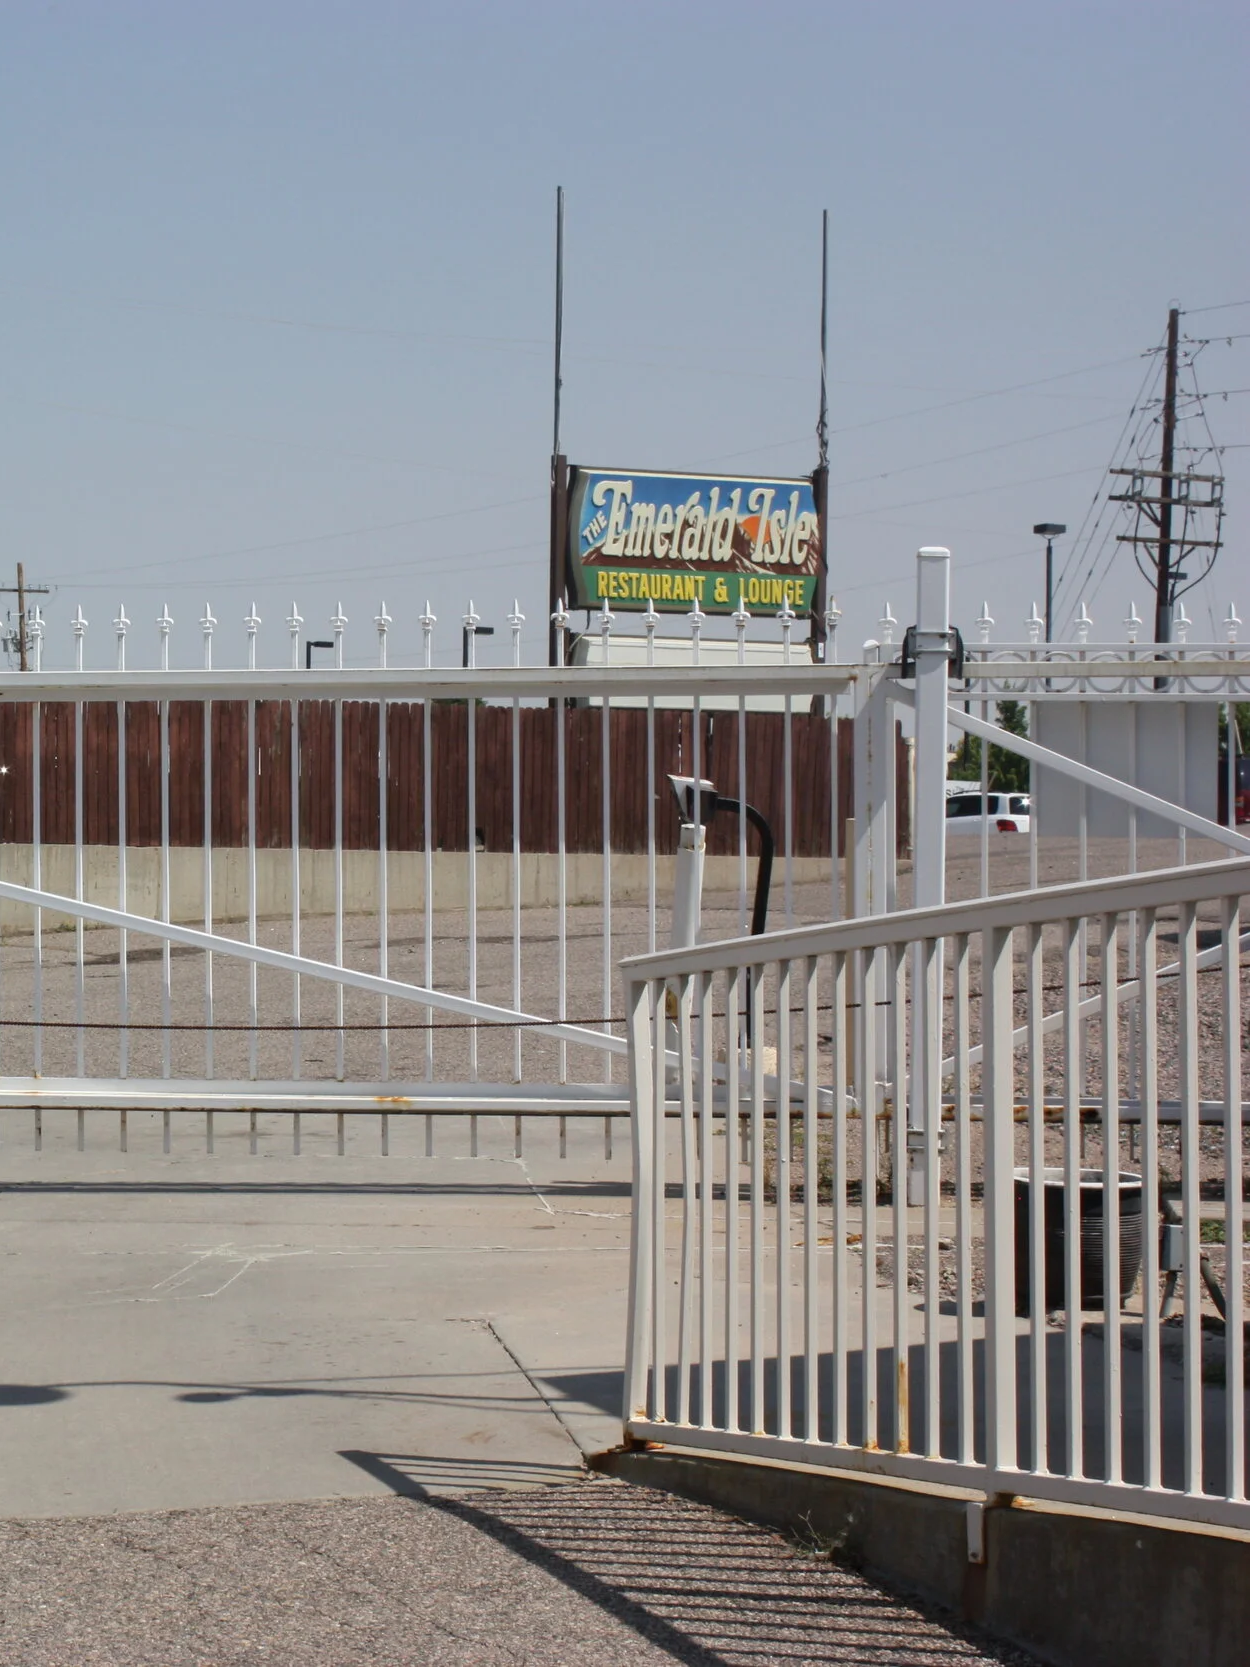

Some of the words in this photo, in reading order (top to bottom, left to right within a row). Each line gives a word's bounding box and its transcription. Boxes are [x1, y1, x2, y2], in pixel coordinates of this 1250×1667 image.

[581, 509, 609, 545] THE
[592, 480, 742, 562] Emerald
[748, 488, 811, 565] Isle
[597, 571, 706, 600] RESTAURANT
[713, 577, 730, 603] &
[738, 577, 805, 605] LOUNGE
